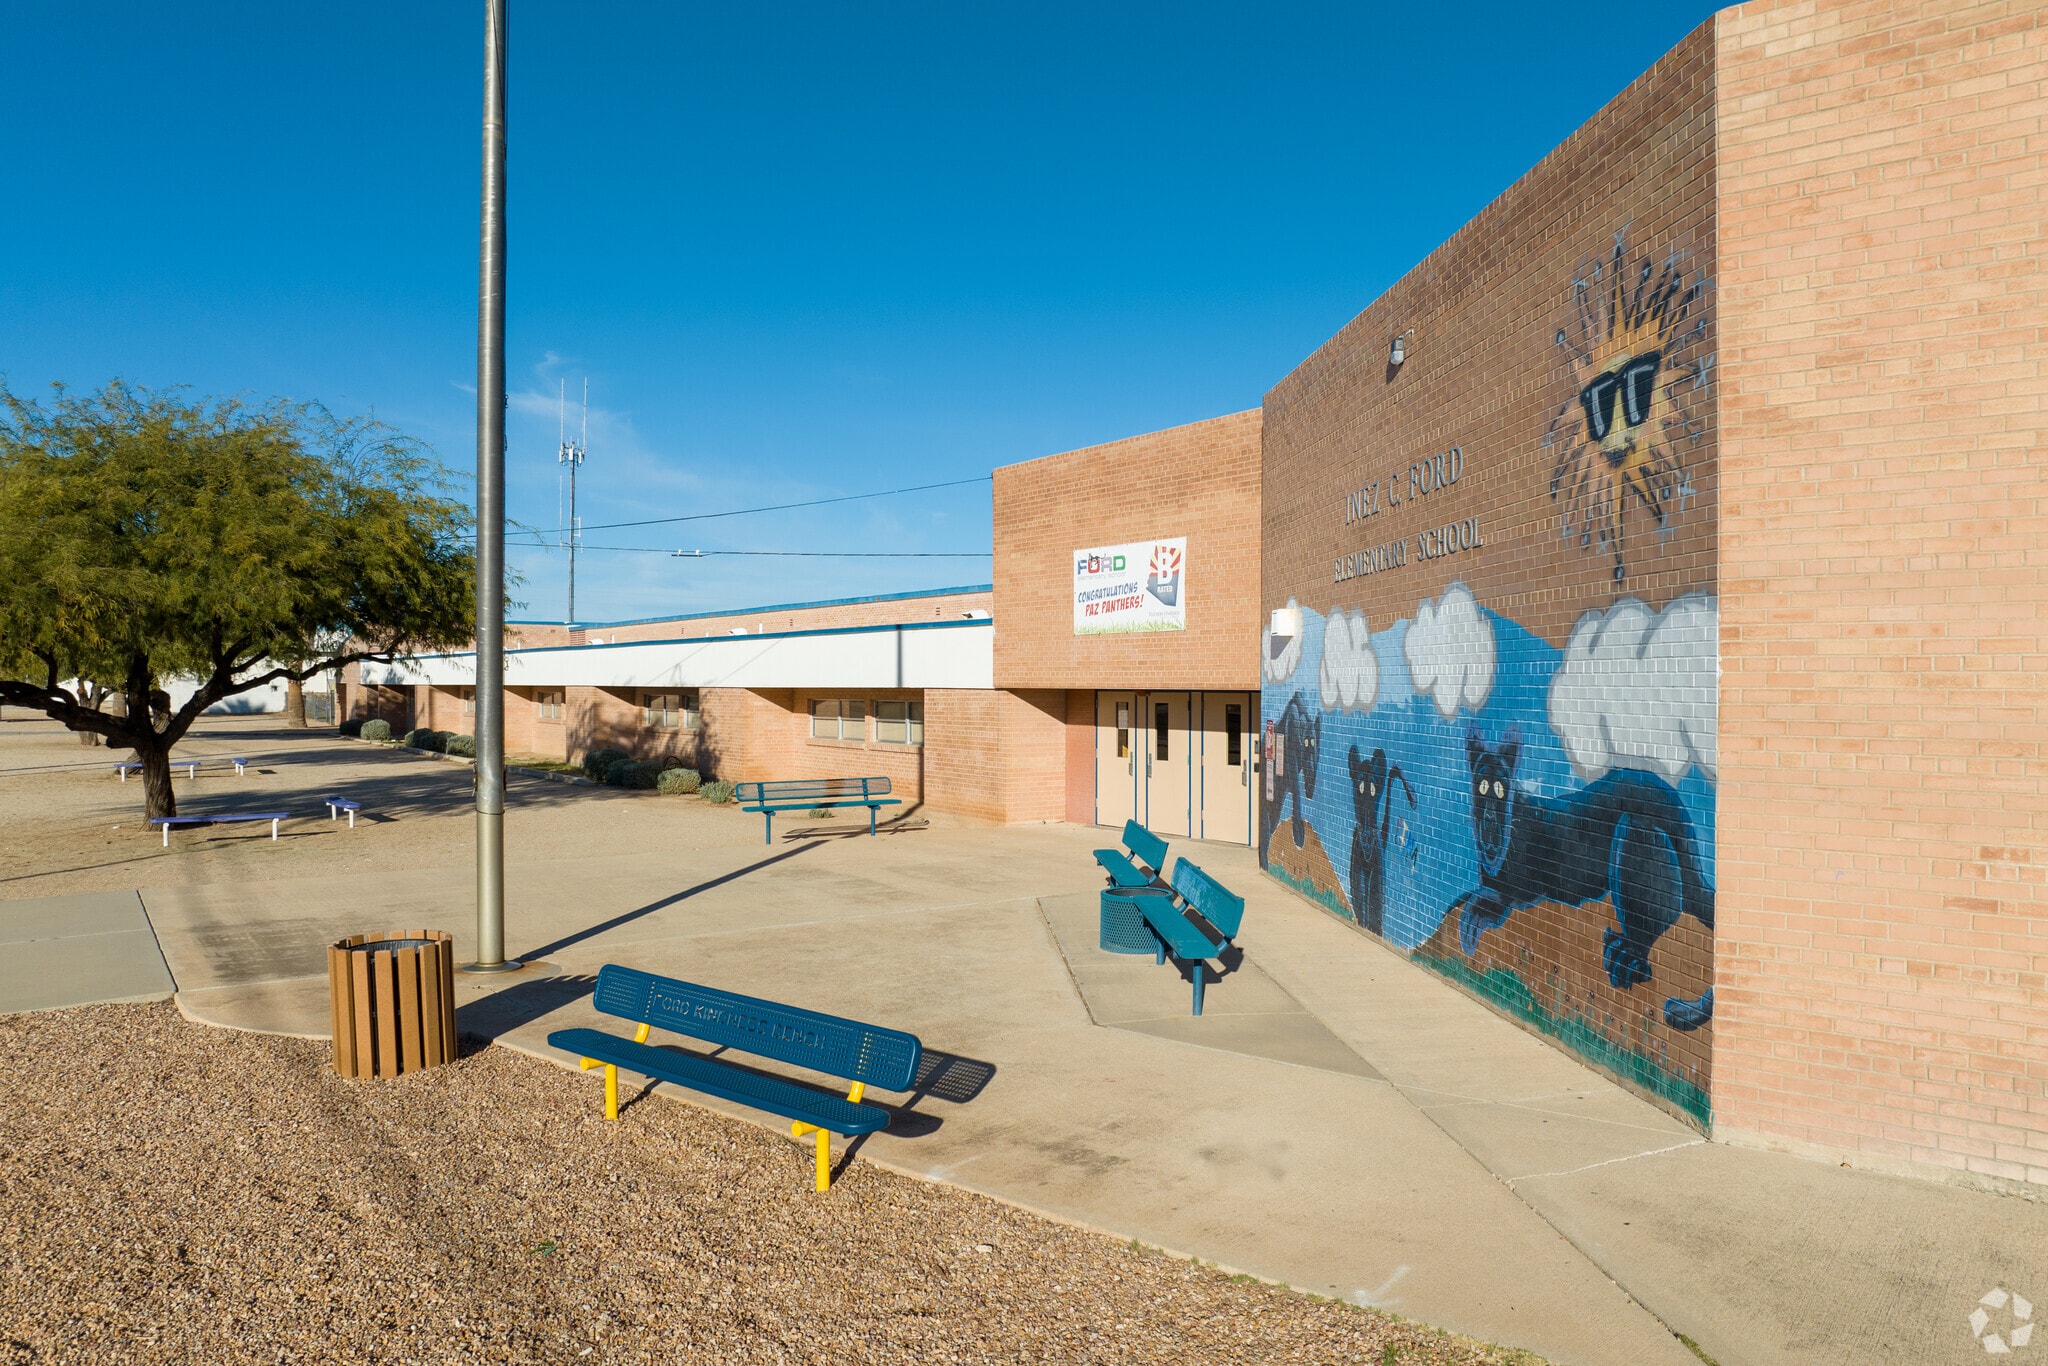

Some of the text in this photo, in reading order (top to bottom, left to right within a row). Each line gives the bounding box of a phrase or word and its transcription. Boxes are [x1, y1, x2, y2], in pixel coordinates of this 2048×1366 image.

[1345, 445, 1464, 525] INEZ C FORD
[1334, 515, 1483, 583] ELEMENTARY SCHOOL
[1077, 555, 1126, 575] FORD
[1078, 581, 1138, 603] CONGRATULATIONS
[1085, 594, 1144, 616] PAZ PANTHERS!
[653, 994, 689, 1015] FORD
